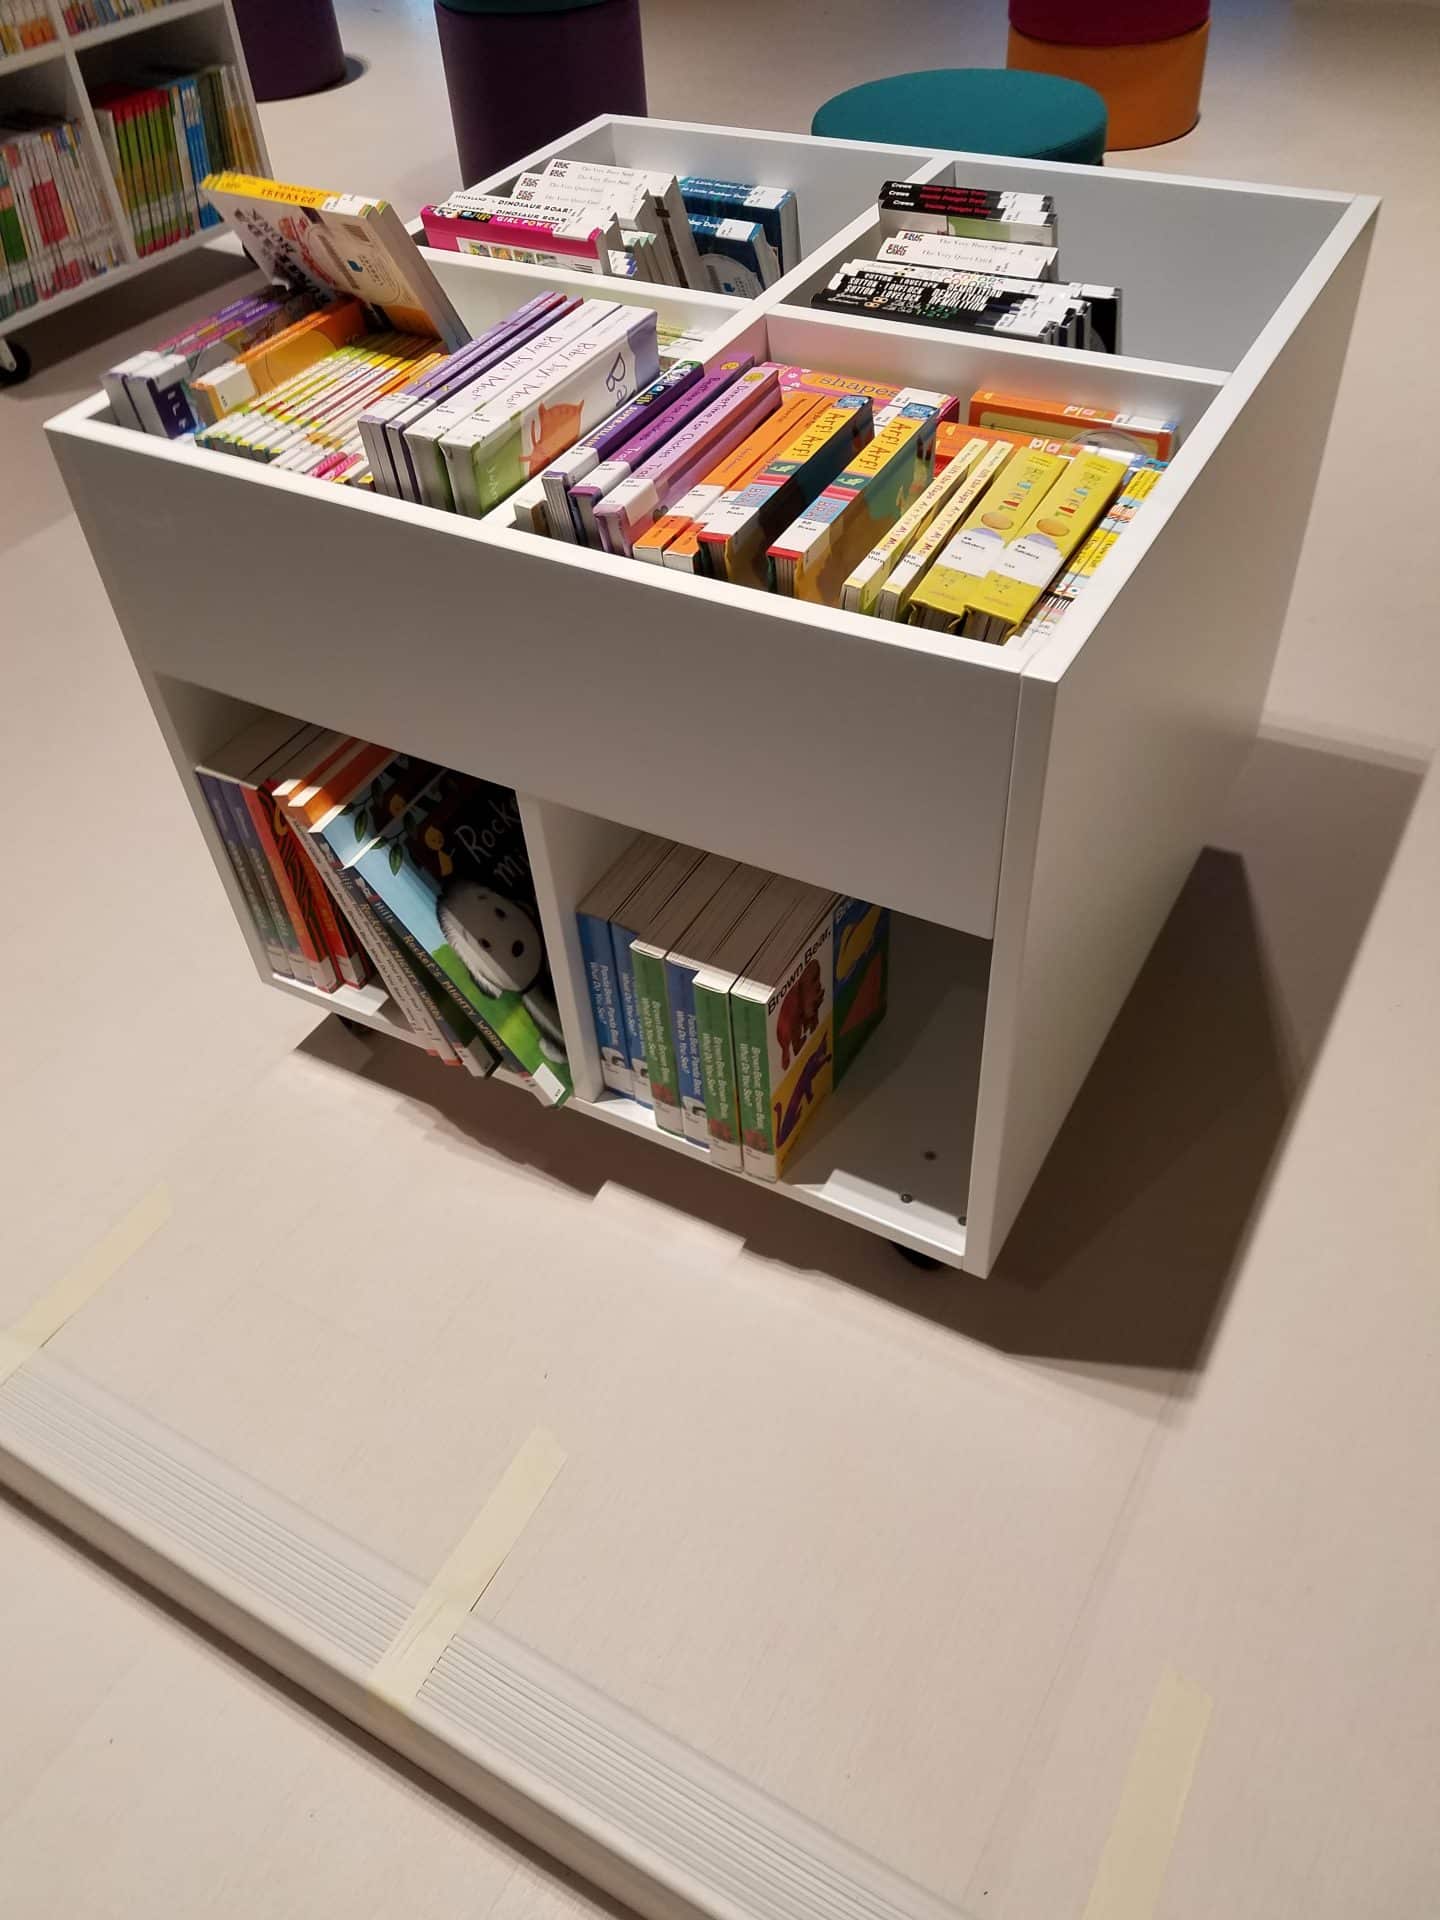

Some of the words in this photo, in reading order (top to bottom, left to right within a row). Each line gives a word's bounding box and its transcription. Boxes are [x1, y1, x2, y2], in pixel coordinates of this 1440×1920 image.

[497, 199, 542, 211] DINOSAUR
[495, 208, 540, 220] DINOSAUR
[496, 216, 519, 225] GIRL
[844, 285, 877, 297] SUTTON
[880, 290, 922, 302] LOVELOCK
[374, 901, 395, 923] Hills
[403, 935, 442, 978] Rocket's
[442, 980, 477, 1017] MIGHTY
[477, 1020, 506, 1051] WORDS
[766, 961, 803, 1017] Brown
